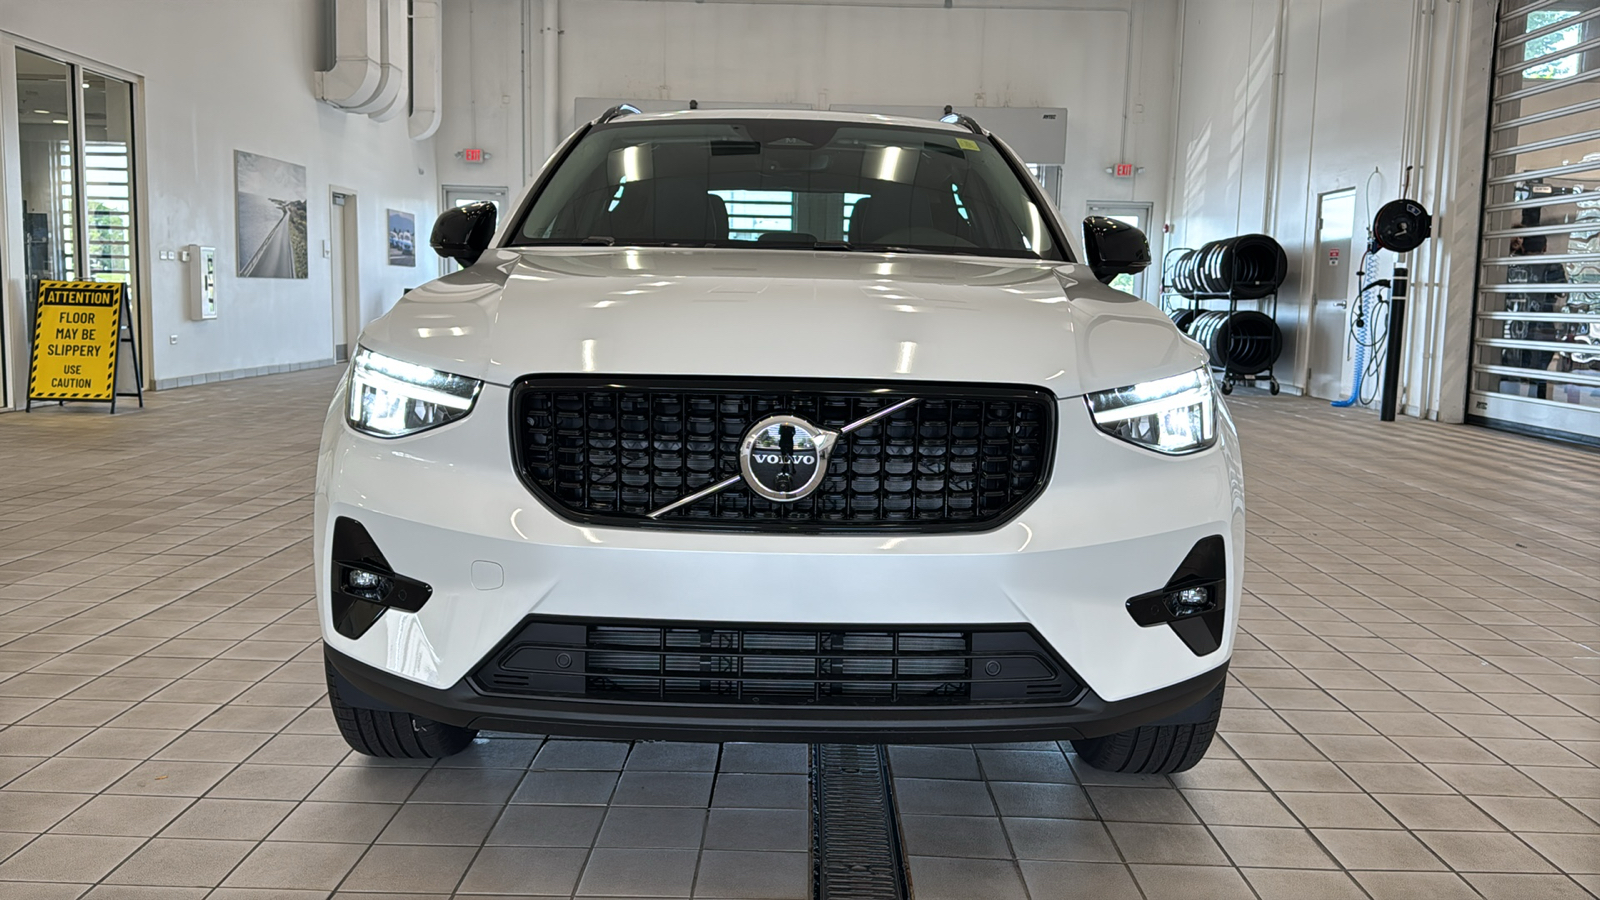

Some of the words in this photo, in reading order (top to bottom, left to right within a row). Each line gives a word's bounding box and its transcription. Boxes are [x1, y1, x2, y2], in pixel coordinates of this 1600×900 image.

[466, 149, 481, 161] EXIT
[1117, 163, 1132, 176] EXIT
[47, 290, 111, 305] ATTENTION
[59, 312, 95, 324] FLOOR
[55, 328, 78, 340] MAY
[81, 328, 97, 341] BE
[47, 344, 101, 357] SLIPPERY
[63, 365, 82, 375] USE
[51, 378, 92, 389] CAUTION
[752, 454, 815, 465] VOLVO
